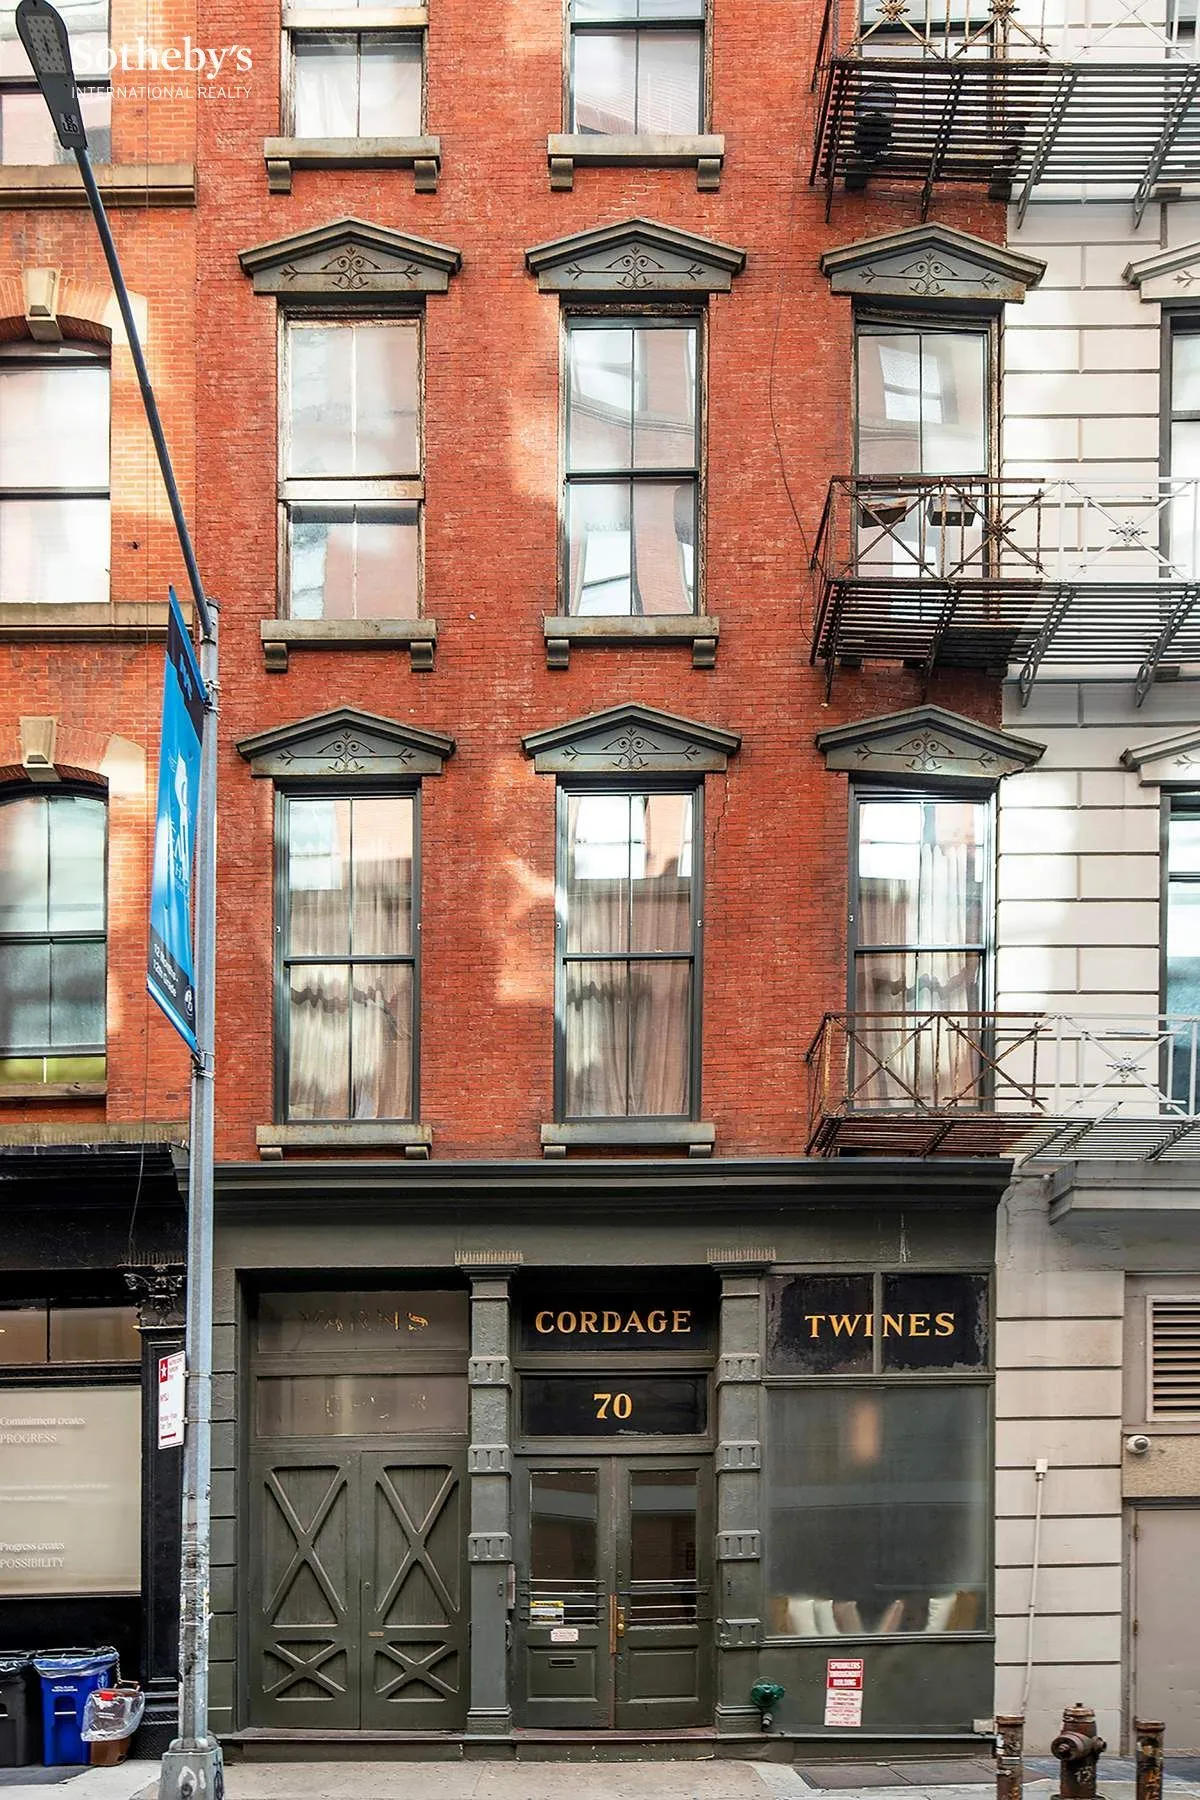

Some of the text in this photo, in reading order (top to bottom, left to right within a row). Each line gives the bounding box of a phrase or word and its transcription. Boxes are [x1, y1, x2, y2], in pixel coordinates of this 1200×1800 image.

[535, 1310, 692, 1334] CORDAGE
[804, 1312, 955, 1338] TWINES
[593, 1393, 633, 1419] 70
[0, 1432, 57, 1444] PROGRESS
[0, 1557, 65, 1568] POSSIBILITY
